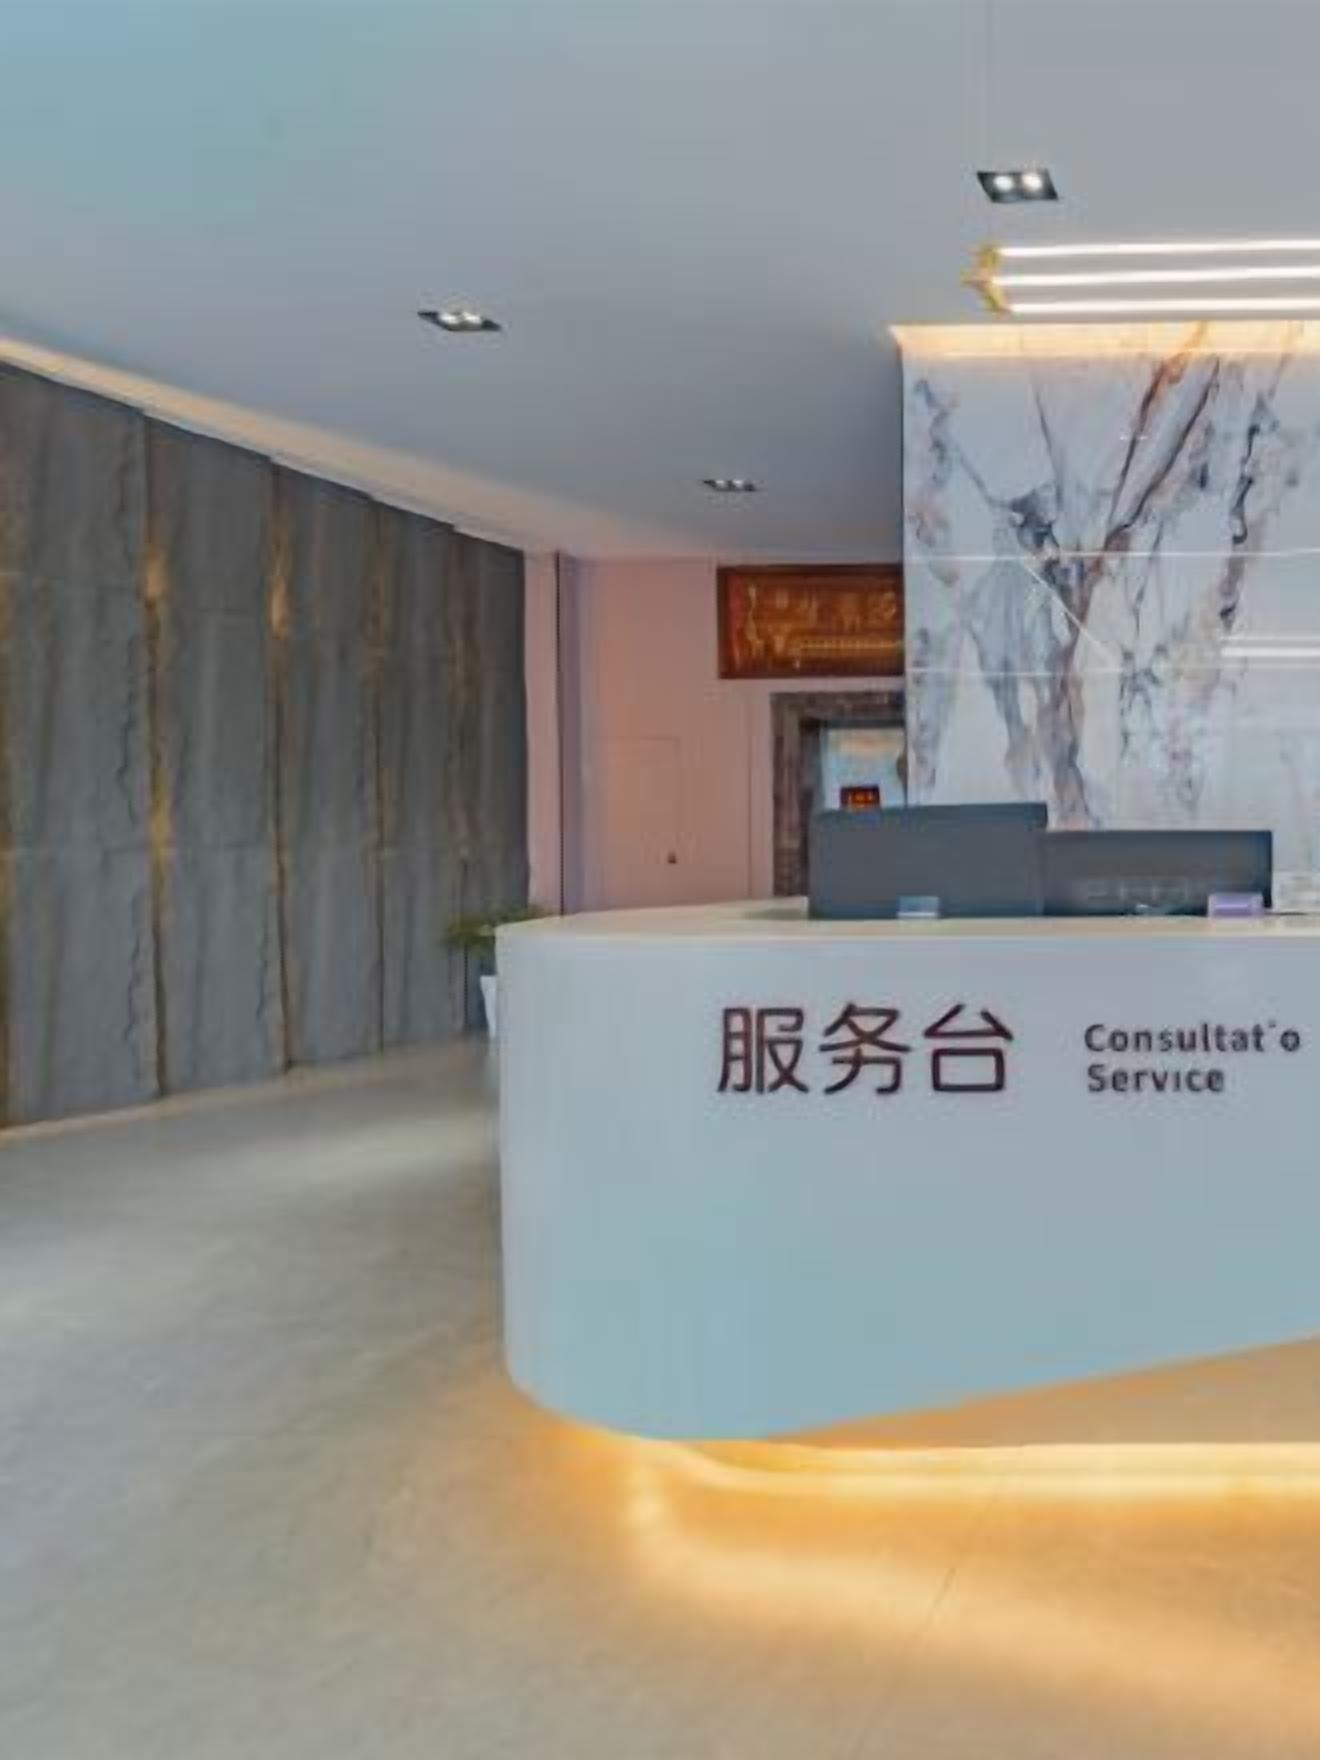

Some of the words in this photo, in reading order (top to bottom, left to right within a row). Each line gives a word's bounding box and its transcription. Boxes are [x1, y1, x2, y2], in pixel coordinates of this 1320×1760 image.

[717, 1001, 1015, 1095] 服务台
[1084, 1020, 1301, 1053] Consultato
[1086, 1062, 1225, 1094] Service
